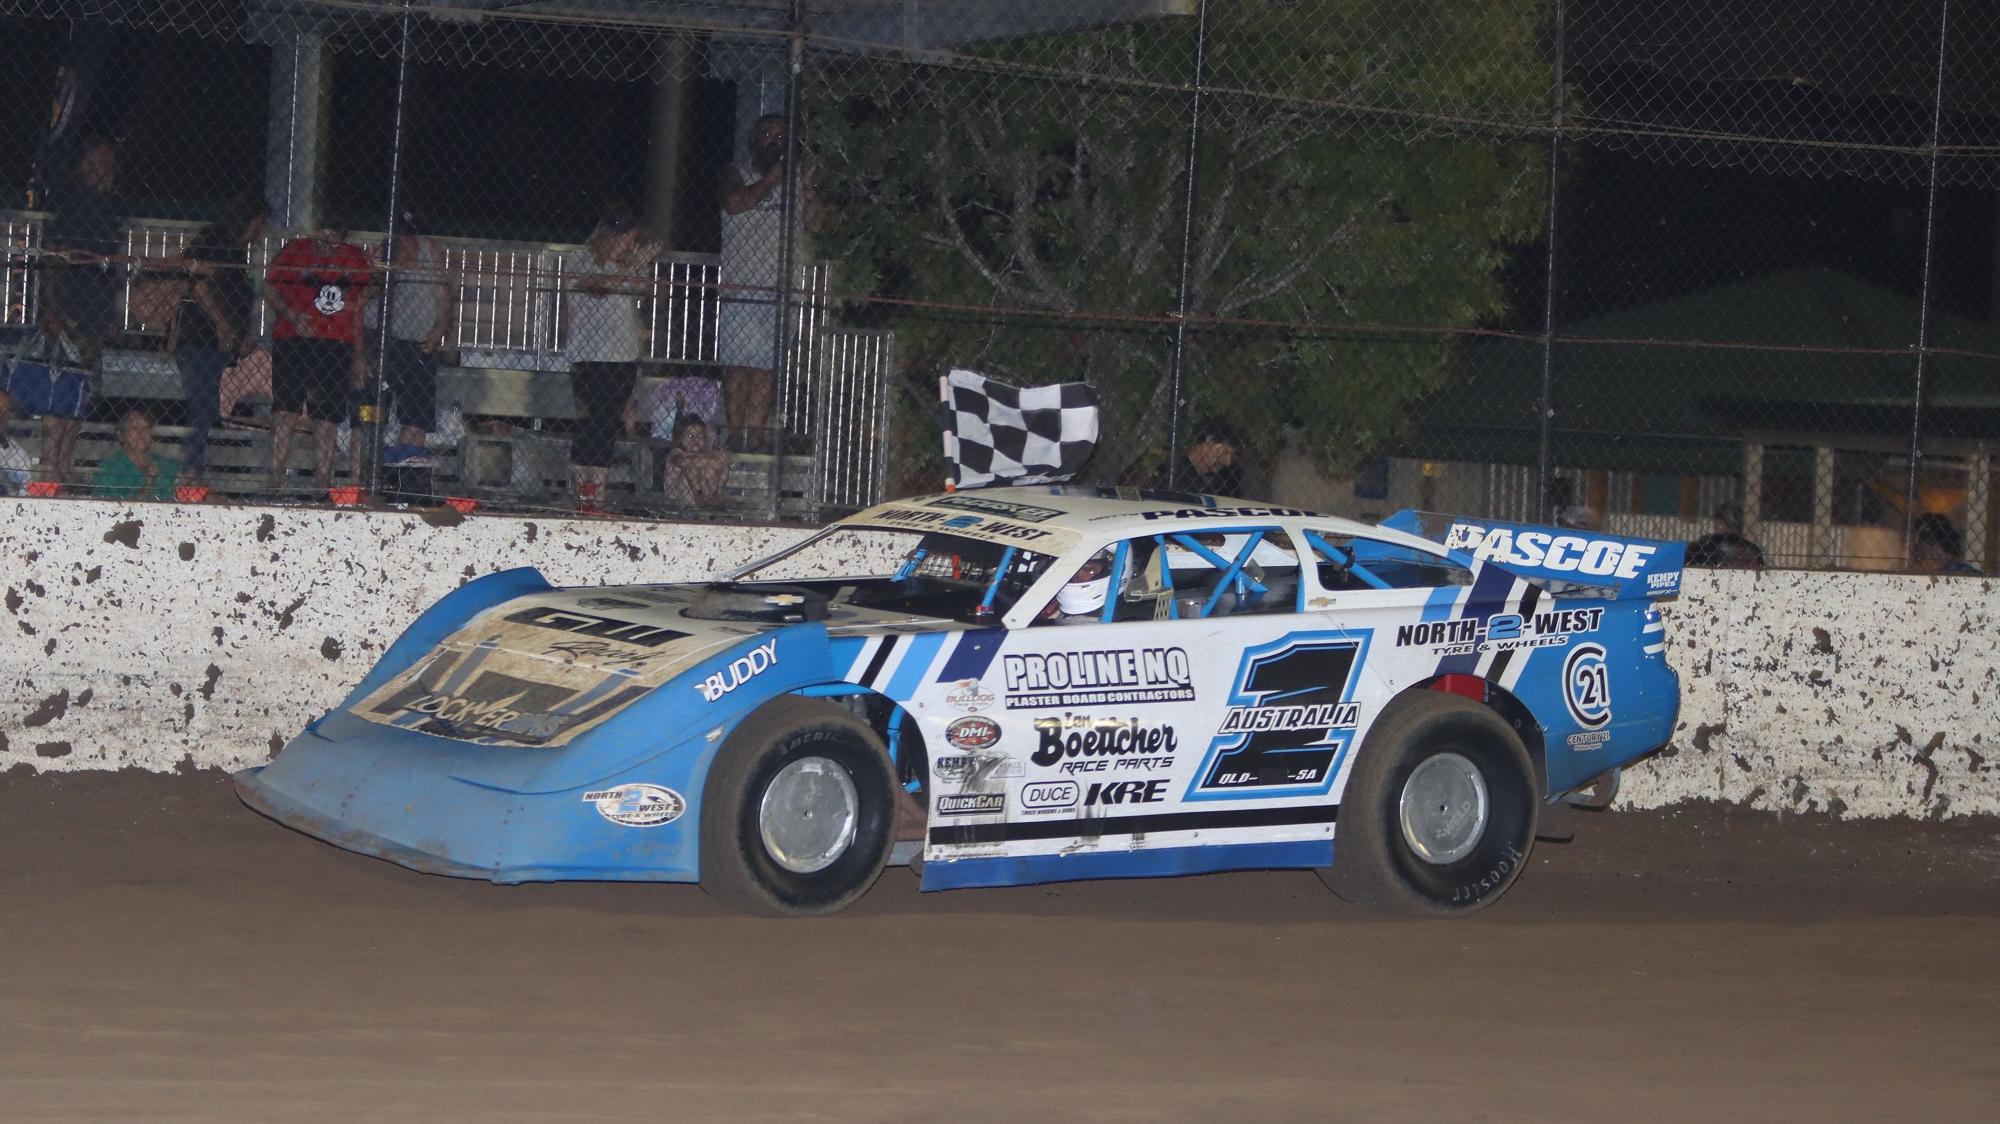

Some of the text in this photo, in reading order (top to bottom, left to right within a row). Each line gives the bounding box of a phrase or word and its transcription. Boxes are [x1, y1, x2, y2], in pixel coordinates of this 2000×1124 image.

[1444, 523, 1656, 579] PASCOE
[1646, 571, 1679, 584] KEMPY
[1650, 581, 1676, 589] PIPES
[1396, 607, 1604, 648] NORTH-2-WEST
[1432, 635, 1569, 655] TYRE & WHEELS
[701, 636, 778, 702] BUDDY
[1004, 646, 1191, 691] PROLINE NQ
[946, 694, 995, 703] BULLDOG
[1006, 688, 1194, 707] PLASTER BOARD CONTRACTORS
[1218, 702, 1361, 734] AUSTRALIA
[958, 726, 988, 738] DMI
[1030, 716, 1178, 767] Boettcher
[1567, 730, 1610, 745] CENTURY 21
[1059, 756, 1175, 776] RACE PARTS
[585, 789, 642, 813] NORTH 2
[1029, 786, 1073, 802] DUCE
[1083, 779, 1171, 806] KRE
[639, 803, 672, 812] WEST
